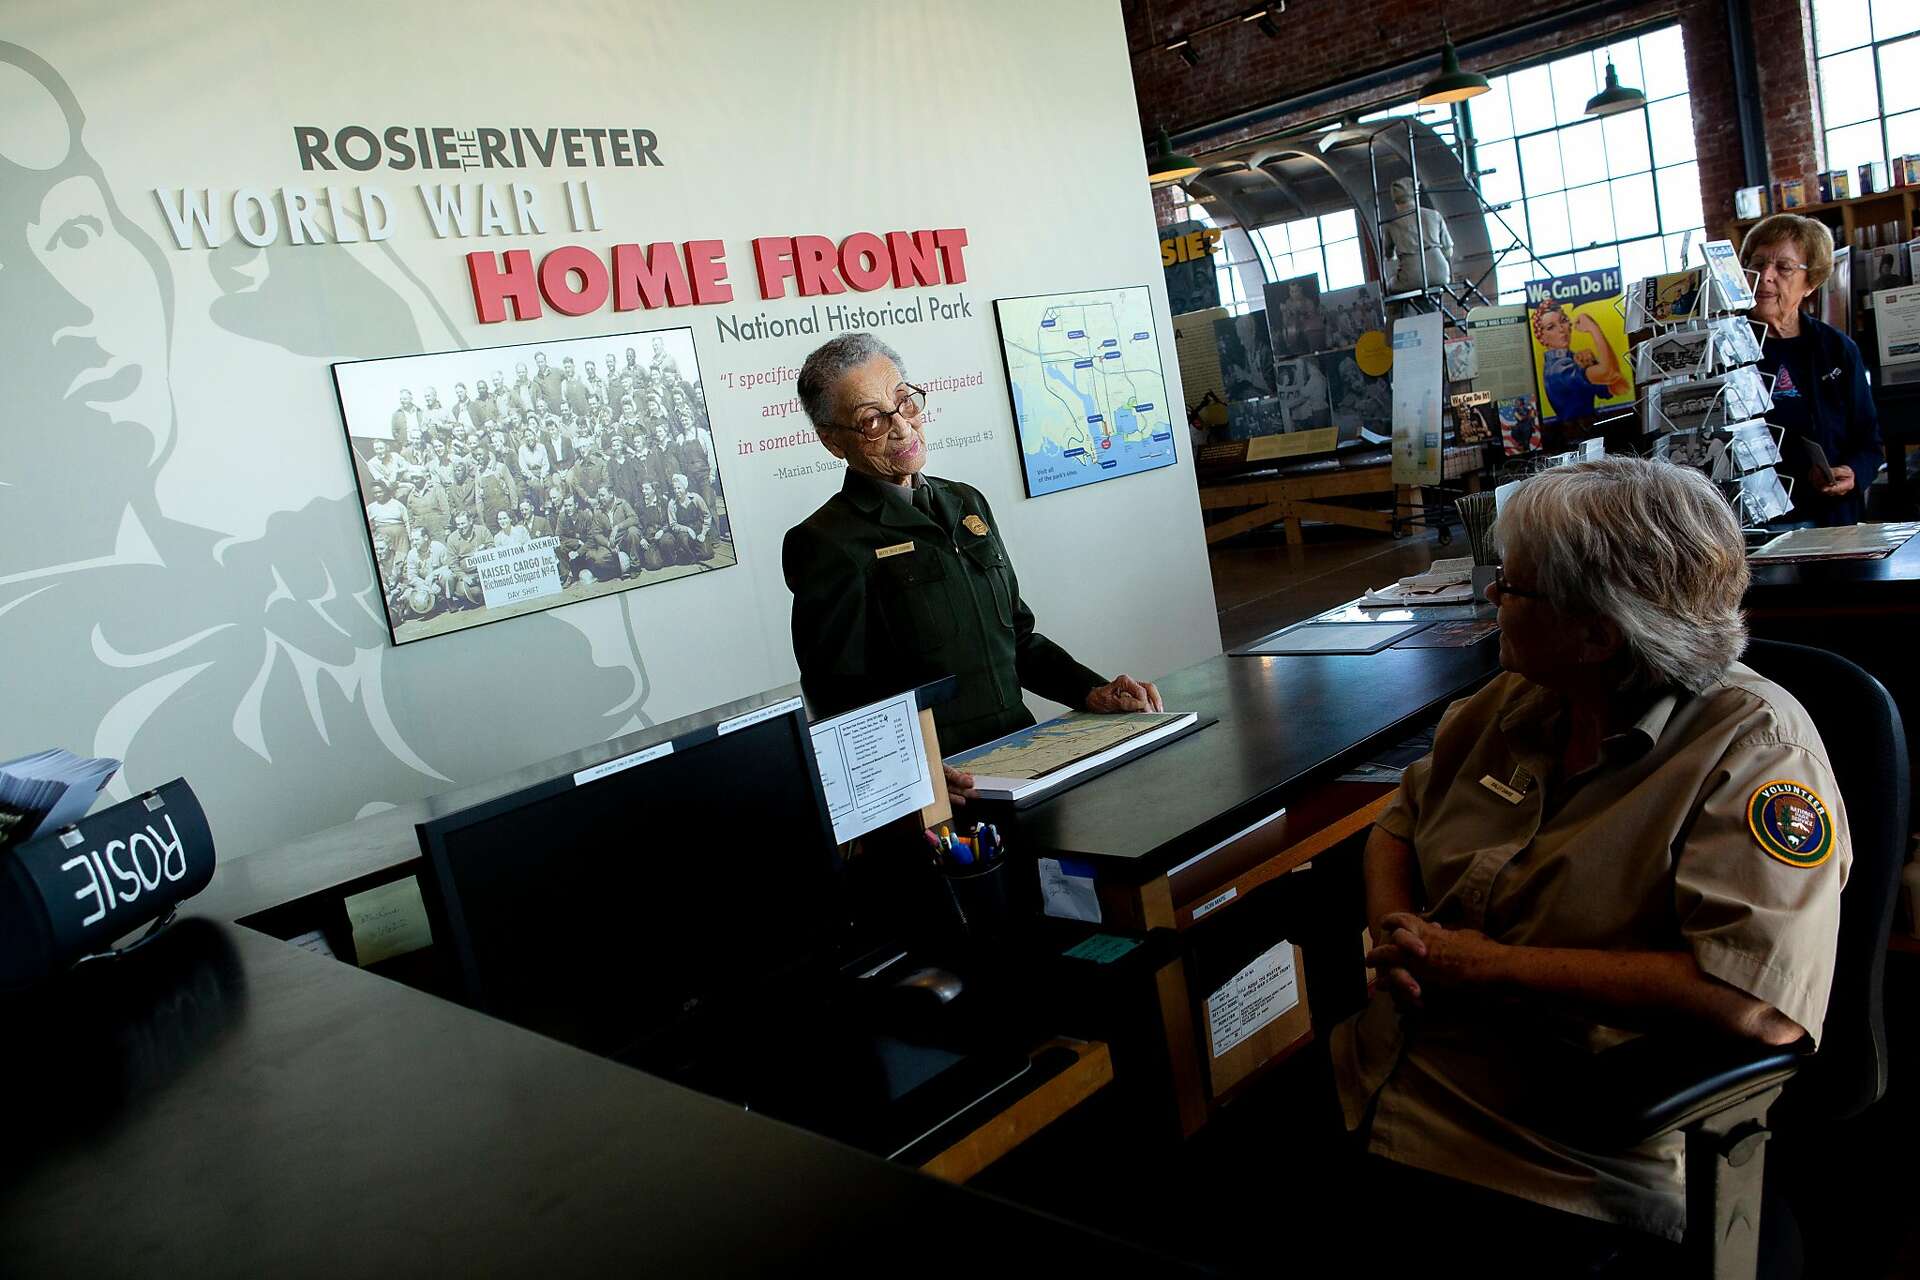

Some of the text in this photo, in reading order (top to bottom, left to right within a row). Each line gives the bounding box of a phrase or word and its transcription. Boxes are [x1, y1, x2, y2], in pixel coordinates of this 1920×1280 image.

[294, 126, 664, 172] ROSIE THE RIVETER
[152, 179, 604, 250] WORLD WAR II
[1160, 228, 1222, 266] SIE?
[465, 228, 969, 325] HOME FRONT
[1527, 271, 1619, 303] We Can Do It!
[716, 292, 973, 343] National Historical Park
[740, 366, 801, 389] specifica
[762, 398, 803, 418] anyth
[738, 439, 753, 455] in
[760, 429, 821, 451] somethi
[945, 432, 981, 448] Shipyard
[983, 430, 994, 441] #3
[467, 536, 560, 567] DOUBLE BOTTOM ASSEMBLY
[480, 563, 511, 580] KAISER
[513, 557, 540, 573] CARGO
[507, 585, 540, 600] DAY SHIFT
[1761, 783, 1826, 815] VOLUNTEER
[61, 813, 187, 928] ROSIE
